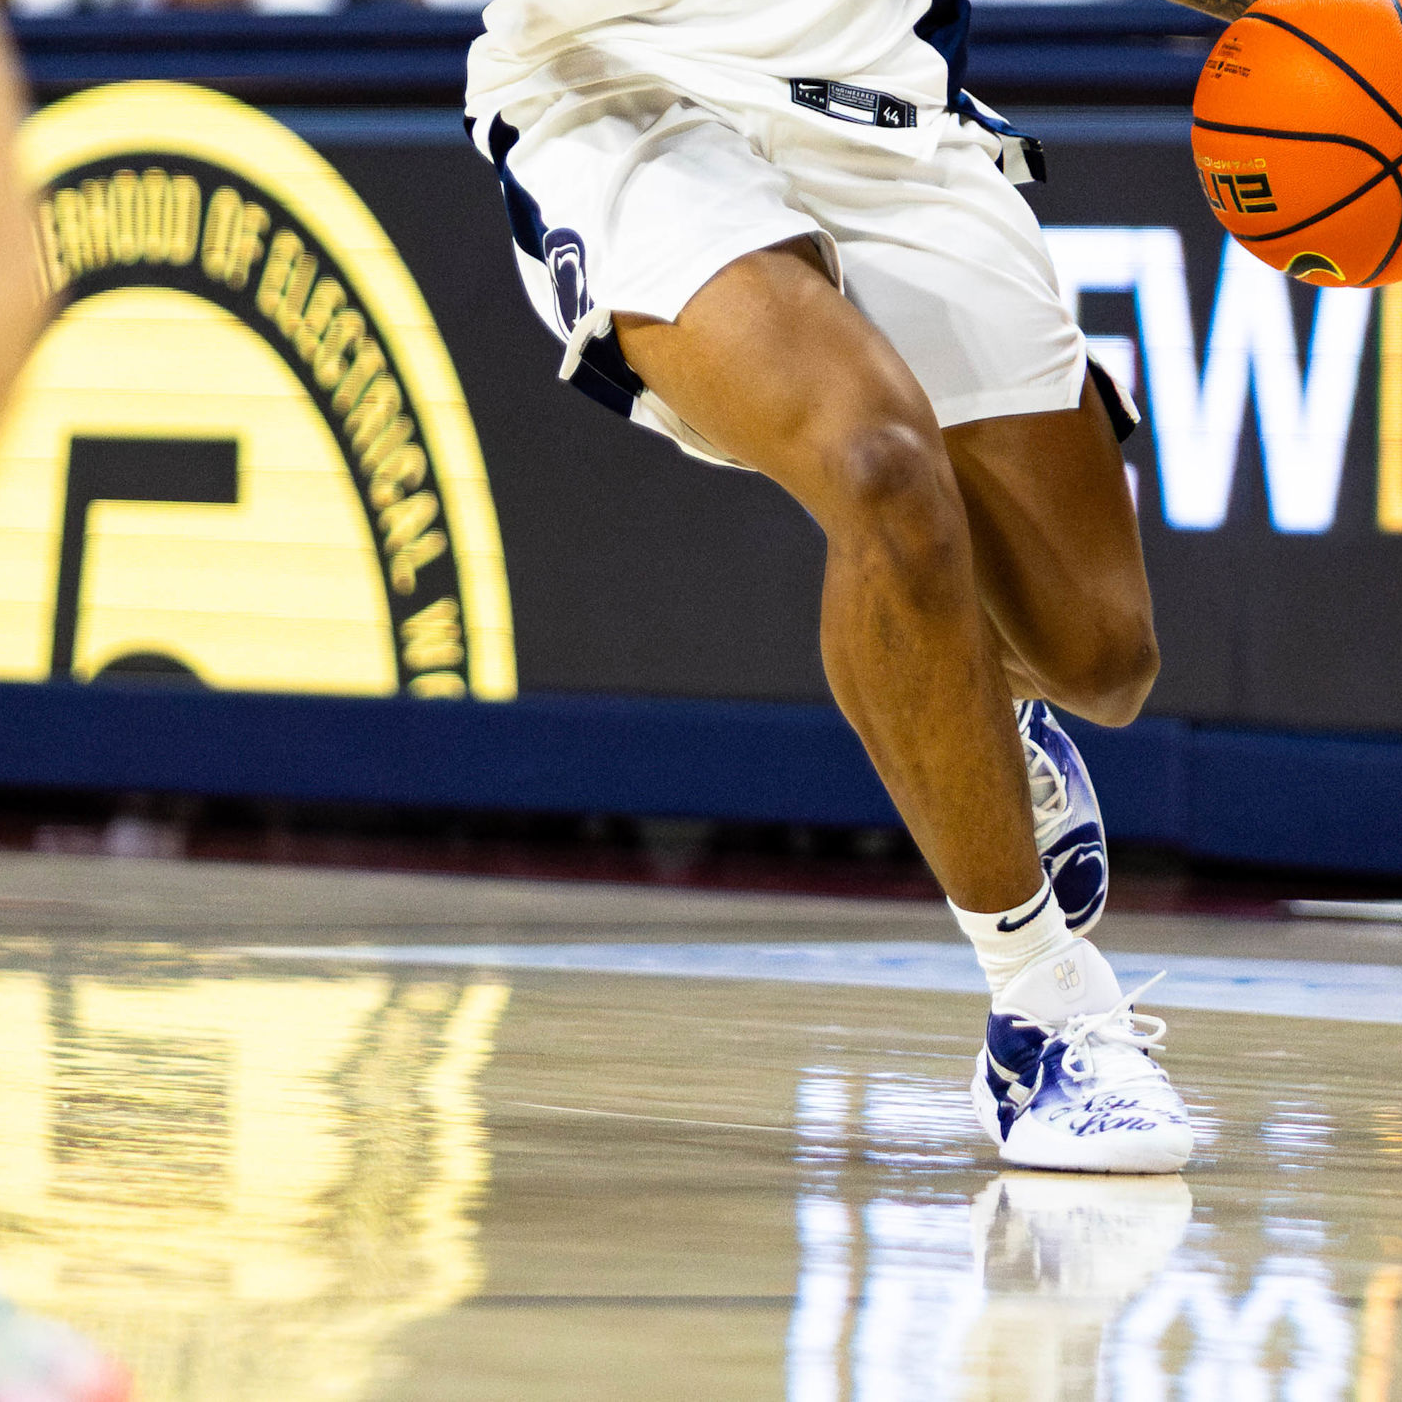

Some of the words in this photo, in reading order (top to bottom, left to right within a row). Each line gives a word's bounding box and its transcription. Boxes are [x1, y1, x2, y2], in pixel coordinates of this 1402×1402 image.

[798, 90, 825, 104] TEAM
[830, 85, 876, 101] ENGINEERED
[883, 105, 900, 126] 44
[1198, 167, 1279, 214] ELIT
[255, 227, 449, 597] ELECTRICAL
